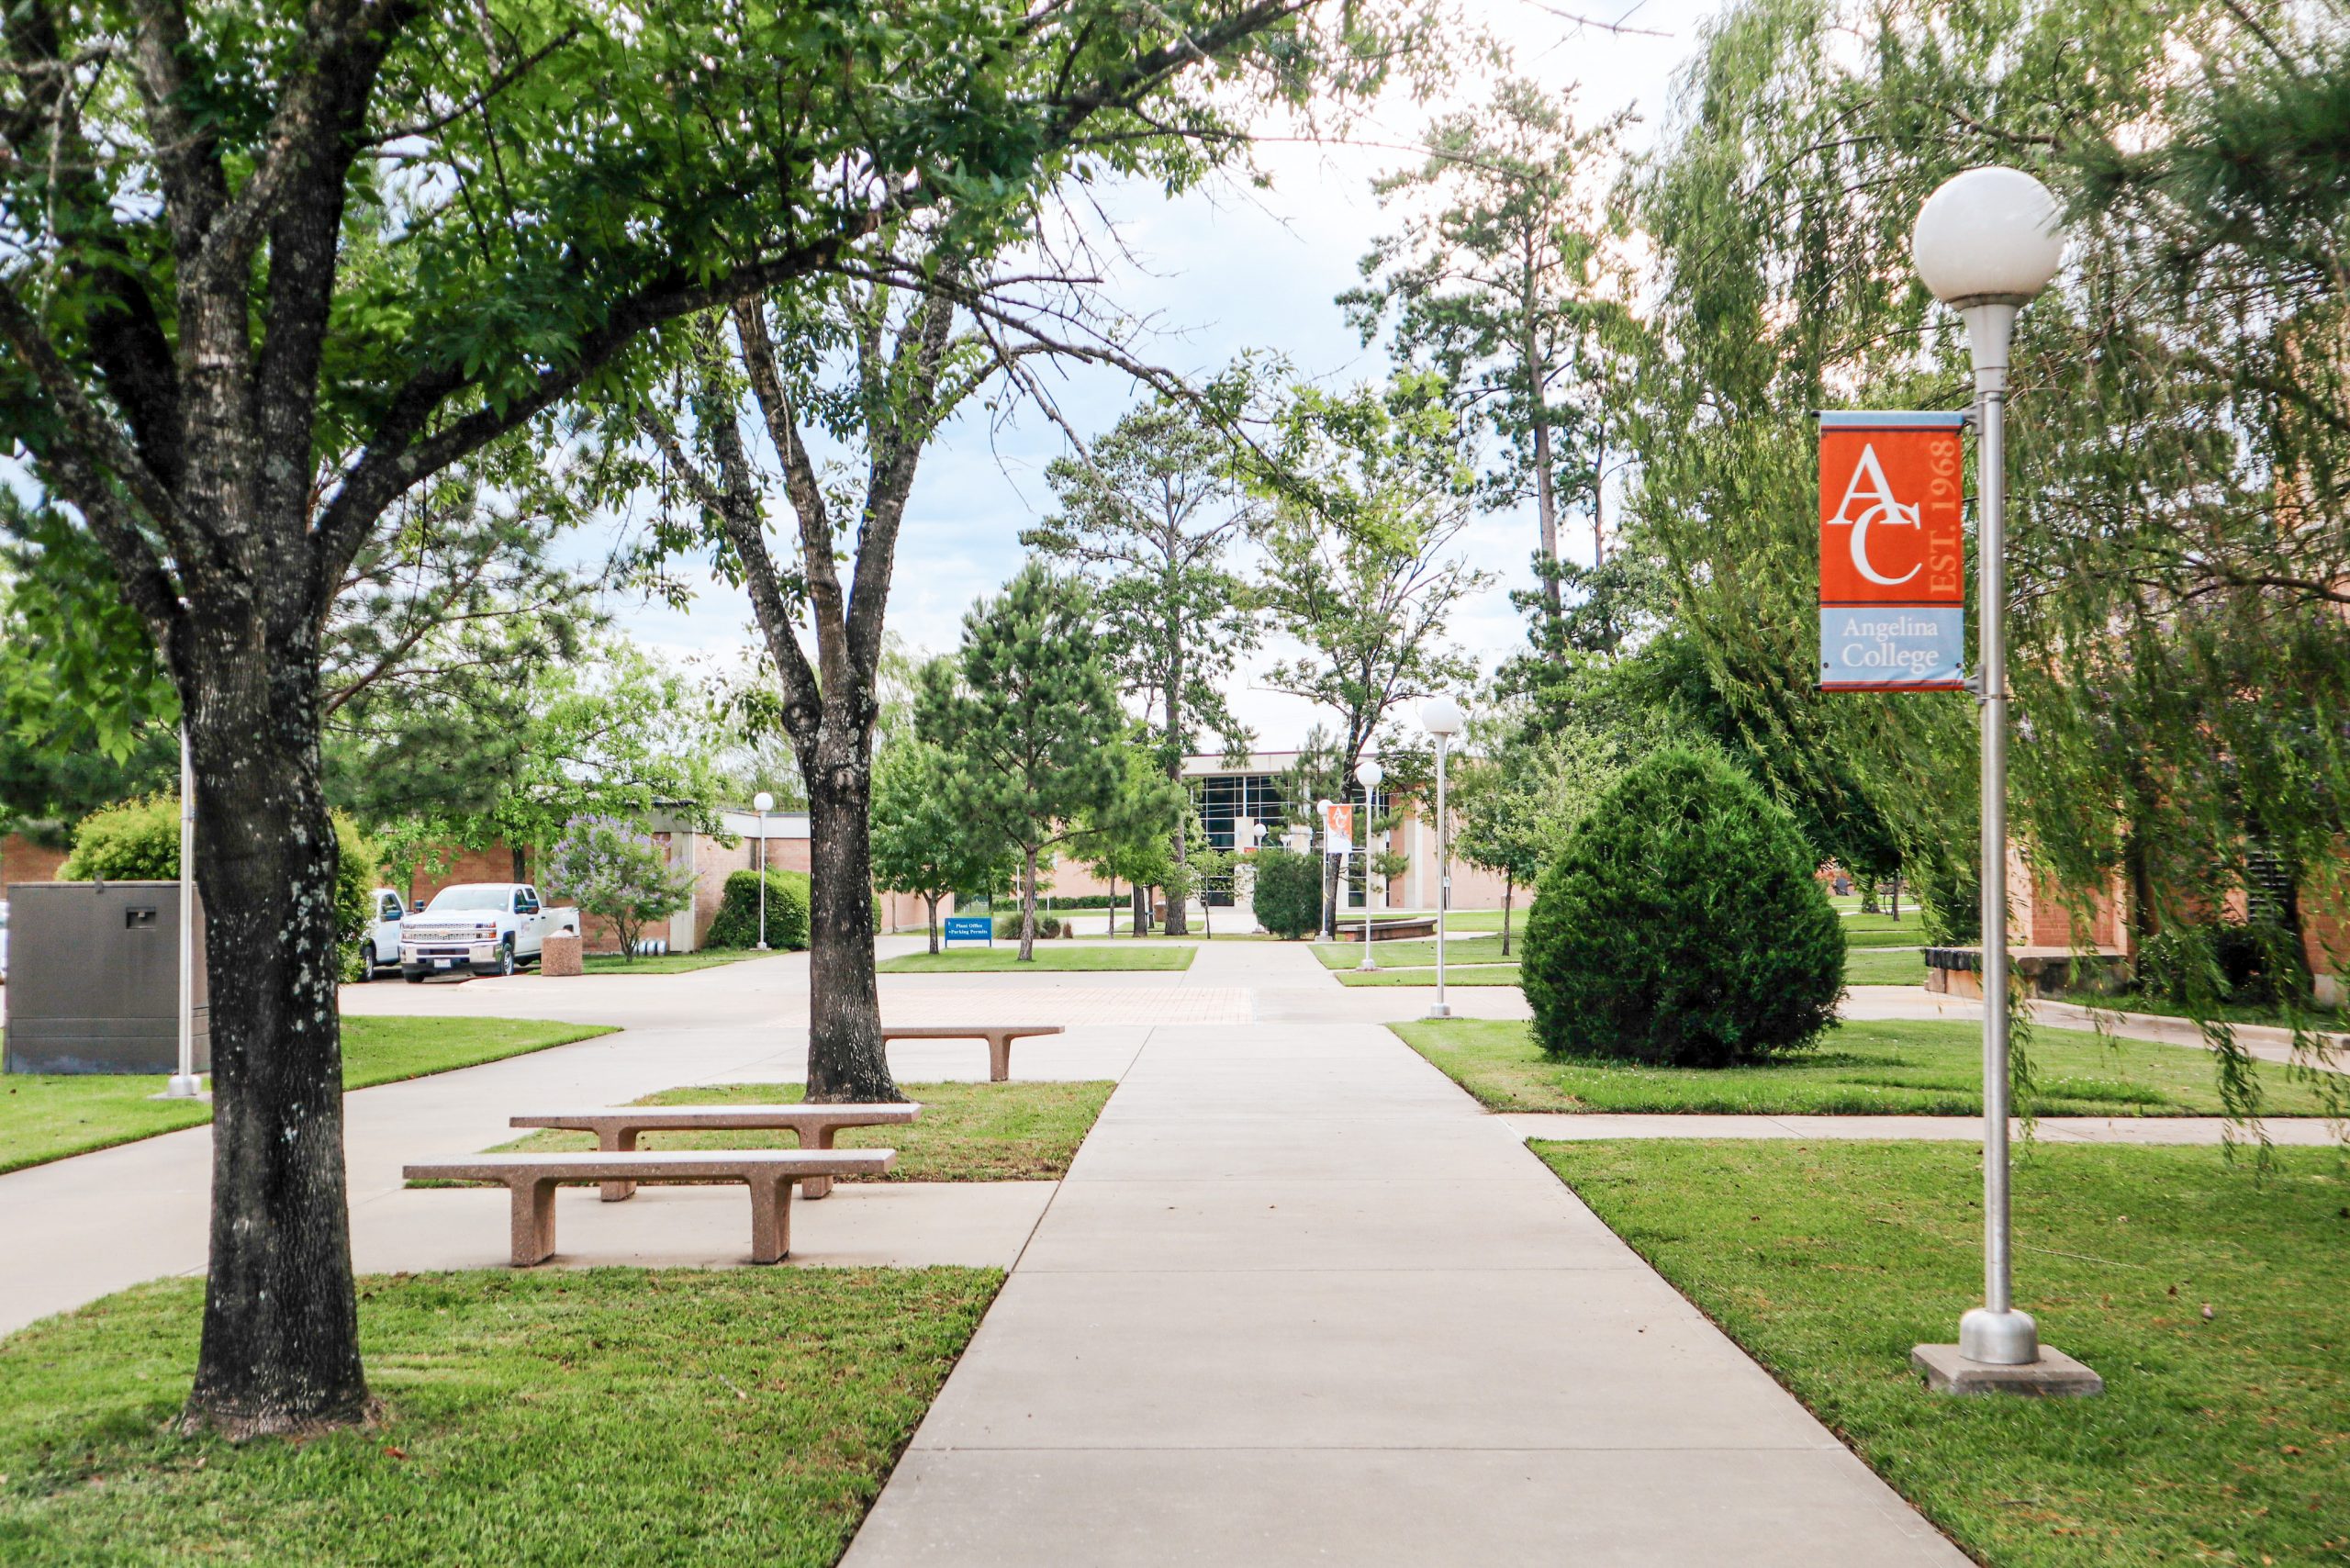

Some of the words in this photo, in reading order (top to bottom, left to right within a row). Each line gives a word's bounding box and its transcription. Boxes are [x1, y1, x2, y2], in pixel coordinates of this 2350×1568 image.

[1930, 440, 1957, 511] 1968
[1826, 442, 1923, 586] AC
[1930, 524, 1957, 594] EST.
[1841, 642, 1940, 675] College
[1842, 615, 1939, 642] Angelina
